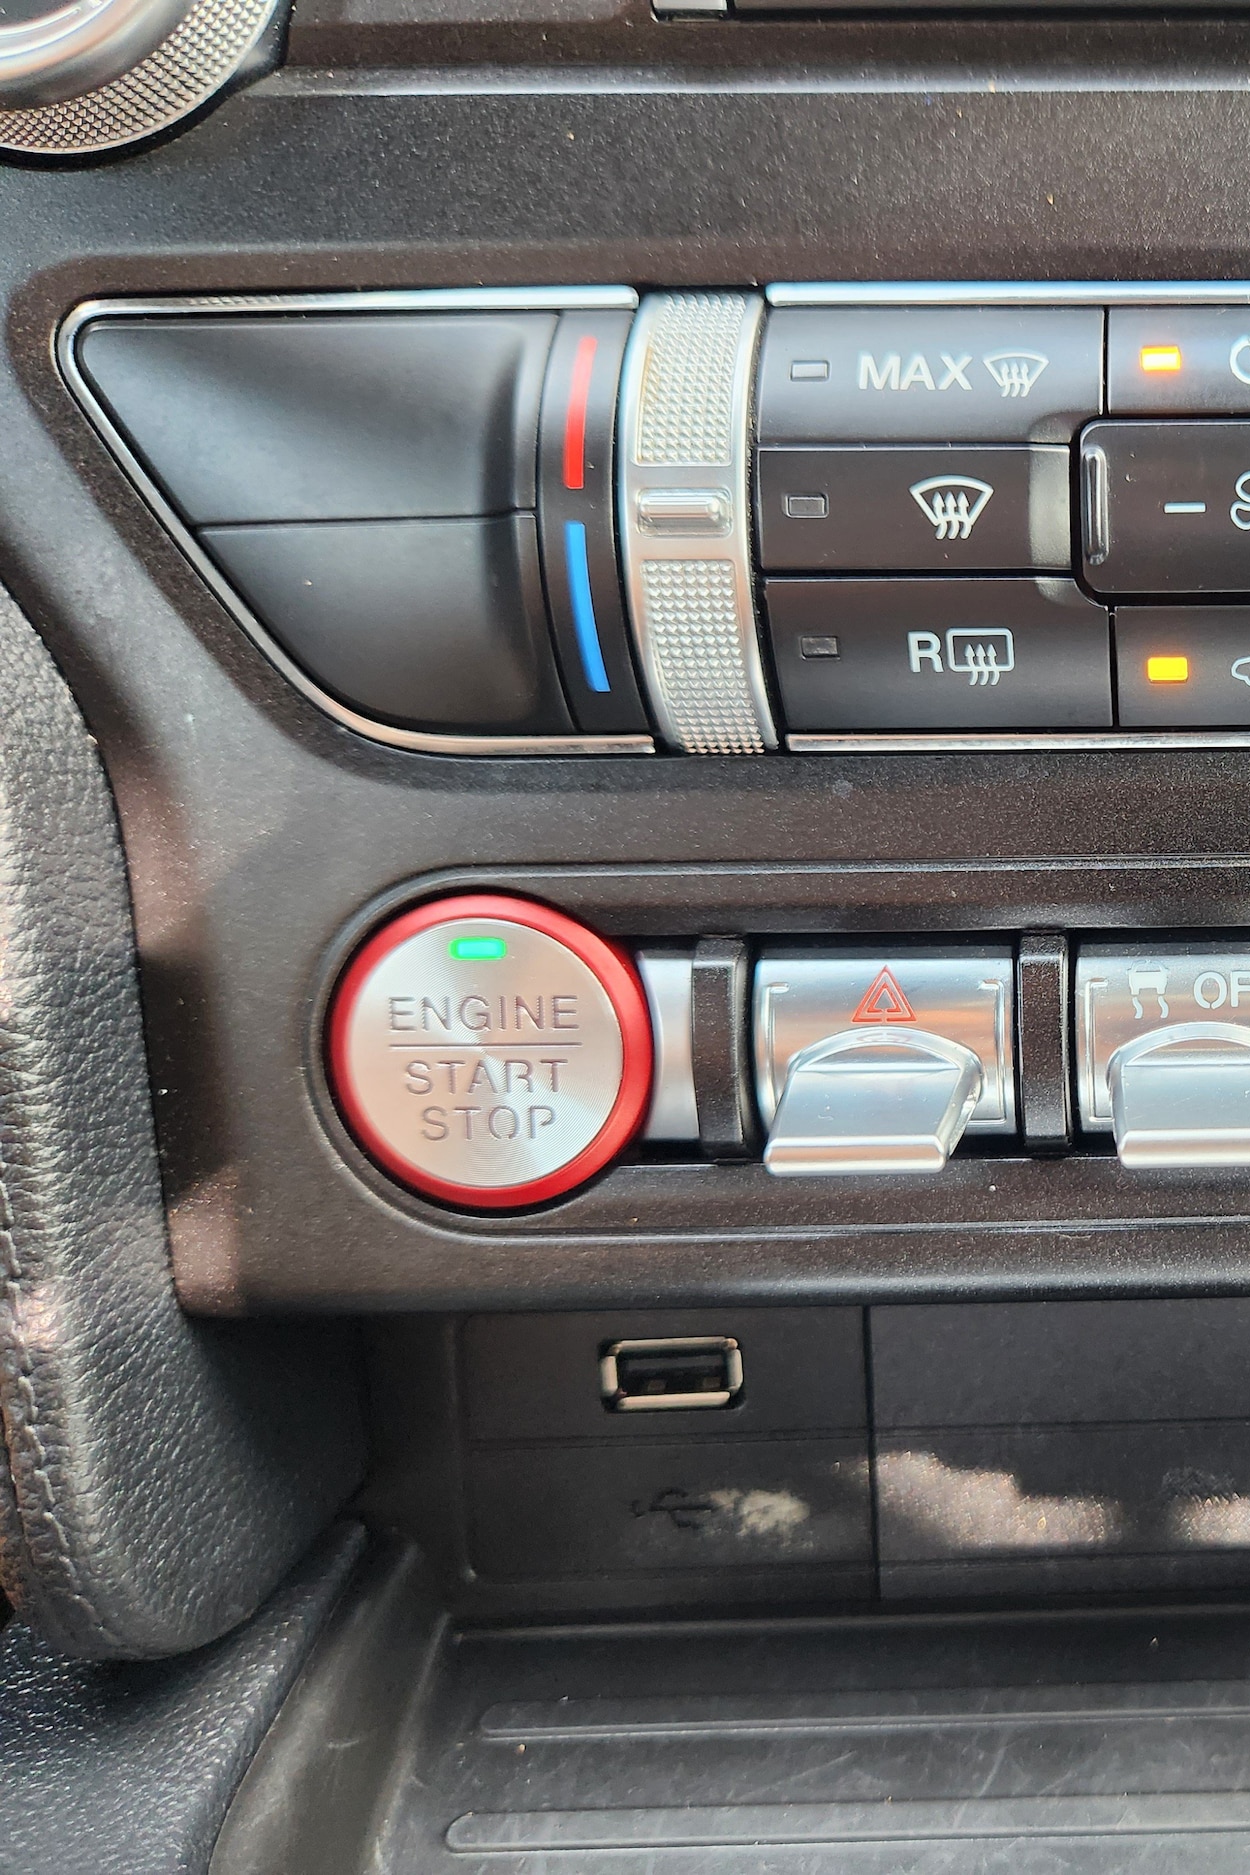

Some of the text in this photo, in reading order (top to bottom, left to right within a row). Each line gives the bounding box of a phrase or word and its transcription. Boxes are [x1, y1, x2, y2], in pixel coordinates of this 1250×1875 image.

[857, 351, 973, 391] MAX
[906, 630, 944, 673] R
[388, 995, 580, 1032] ENGINE
[405, 1058, 569, 1095] START
[420, 1105, 557, 1141] STOP
